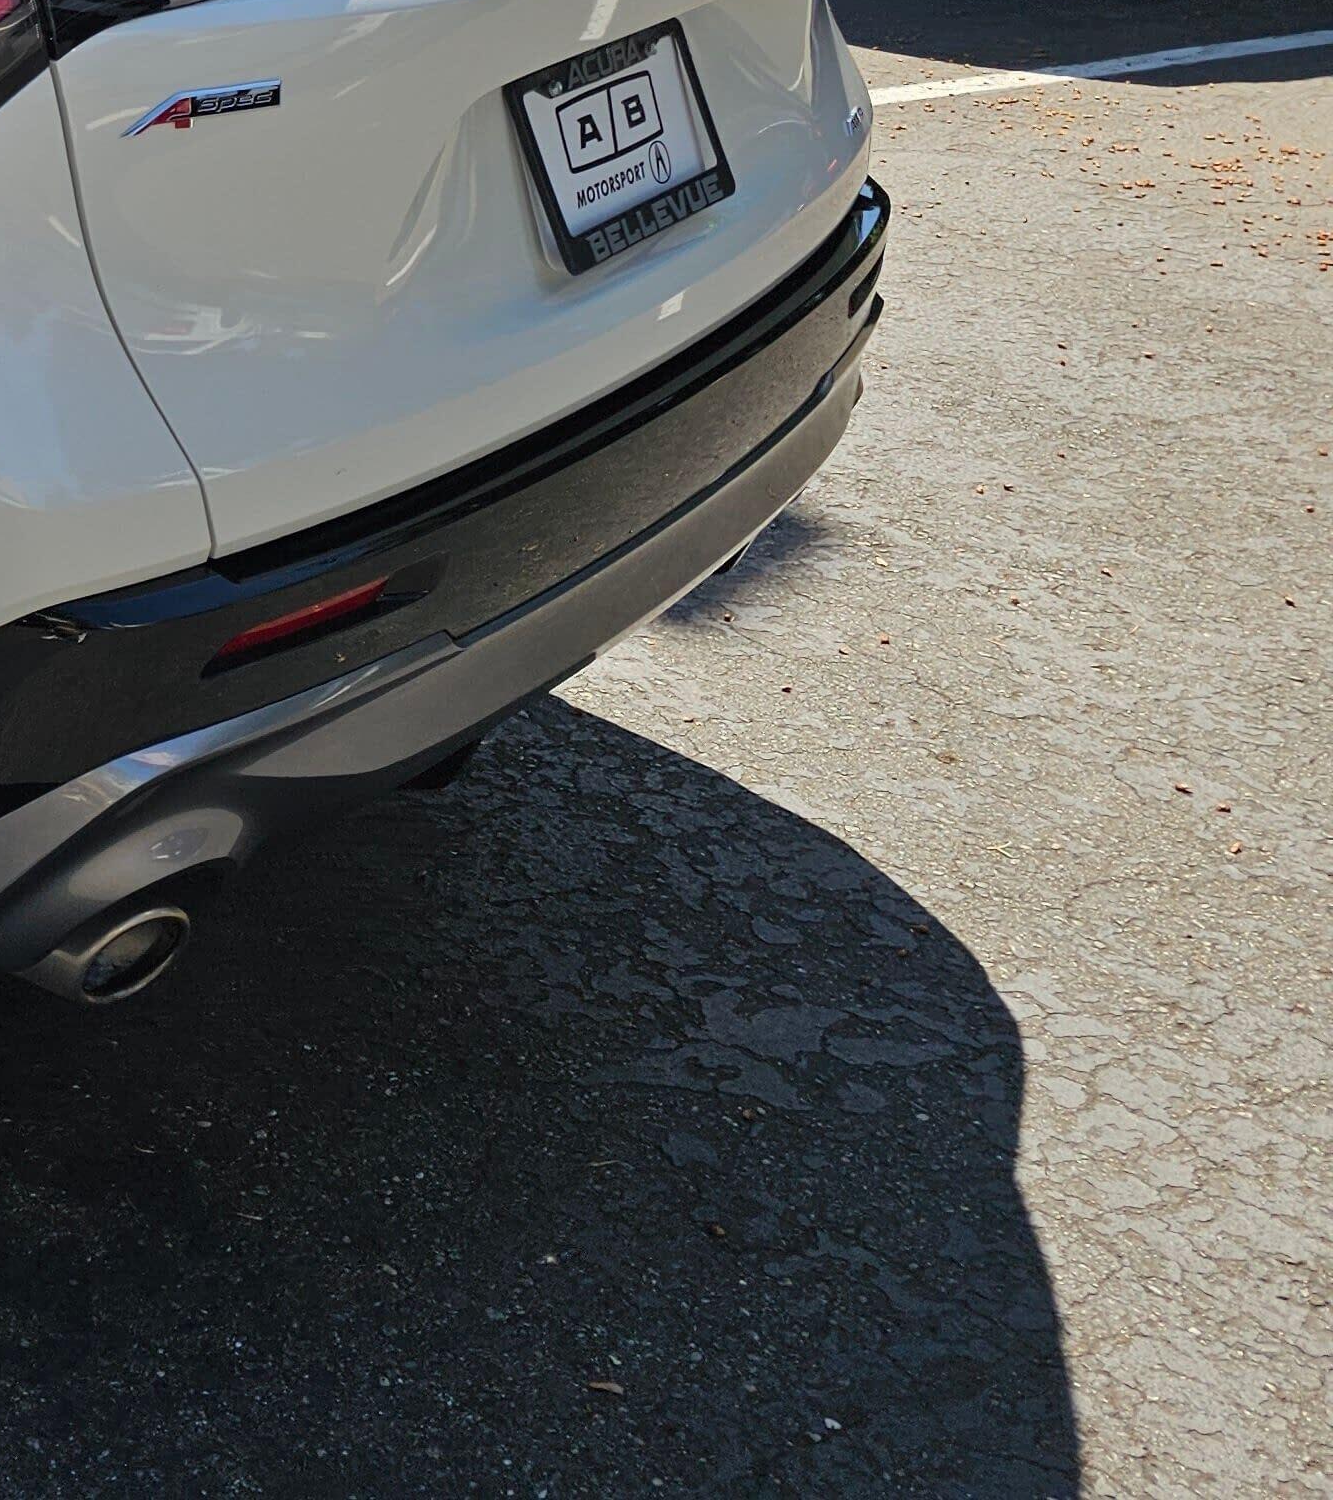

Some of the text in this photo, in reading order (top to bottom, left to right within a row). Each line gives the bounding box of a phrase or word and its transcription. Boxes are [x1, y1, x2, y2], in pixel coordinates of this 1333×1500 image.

[566, 41, 640, 91] ACURA
[576, 94, 647, 150] A B
[576, 160, 647, 210] MOTORSPORT
[583, 173, 725, 262] BELLEVUE
